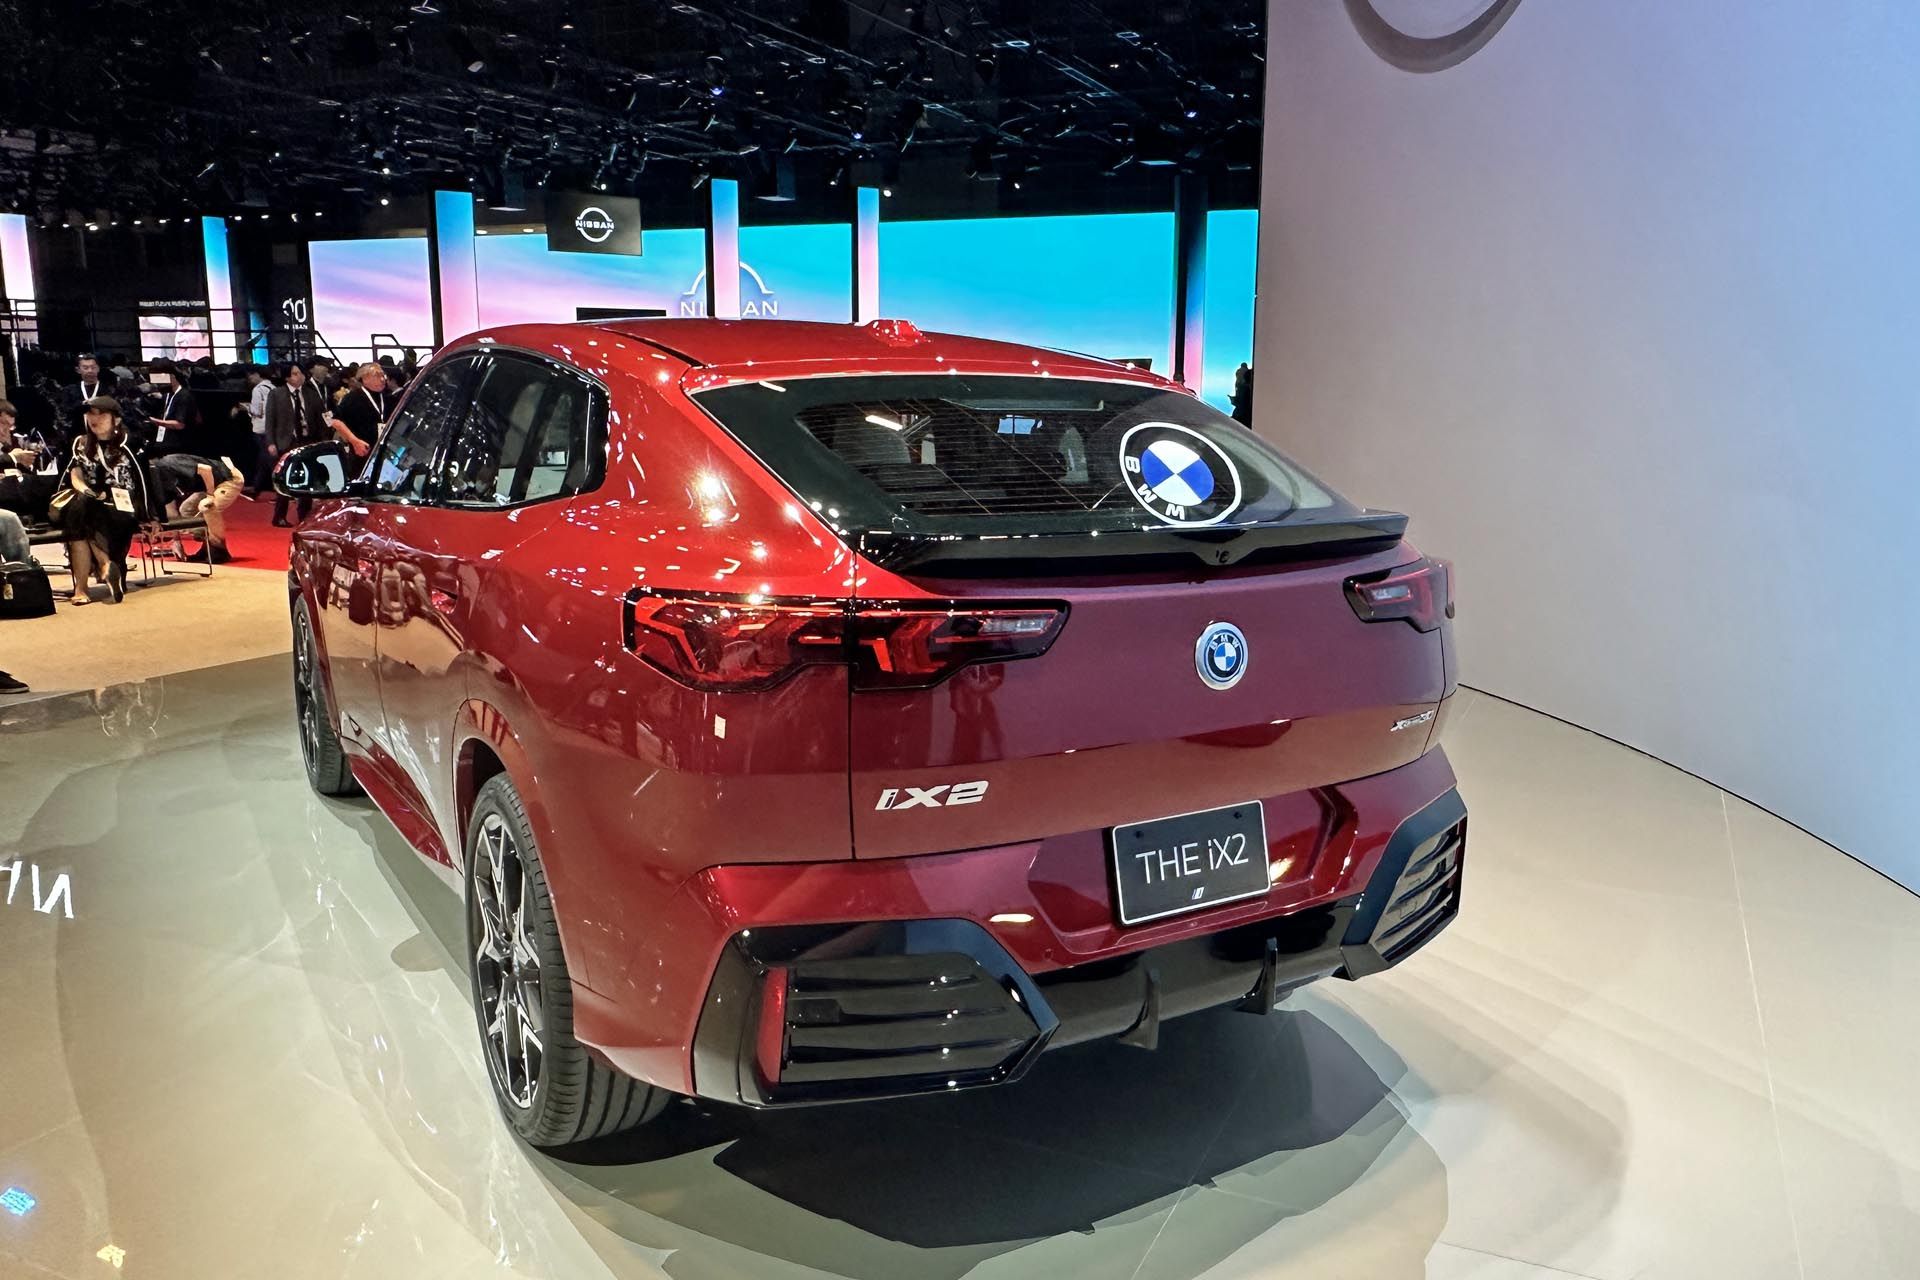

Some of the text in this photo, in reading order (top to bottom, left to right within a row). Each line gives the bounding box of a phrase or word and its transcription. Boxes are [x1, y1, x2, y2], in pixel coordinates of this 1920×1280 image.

[575, 219, 615, 231] NISSAN
[680, 300, 778, 317] NIAN
[1209, 634, 1240, 651] BMW
[874, 780, 989, 811] iX2
[1135, 832, 1249, 885] THE iX2
